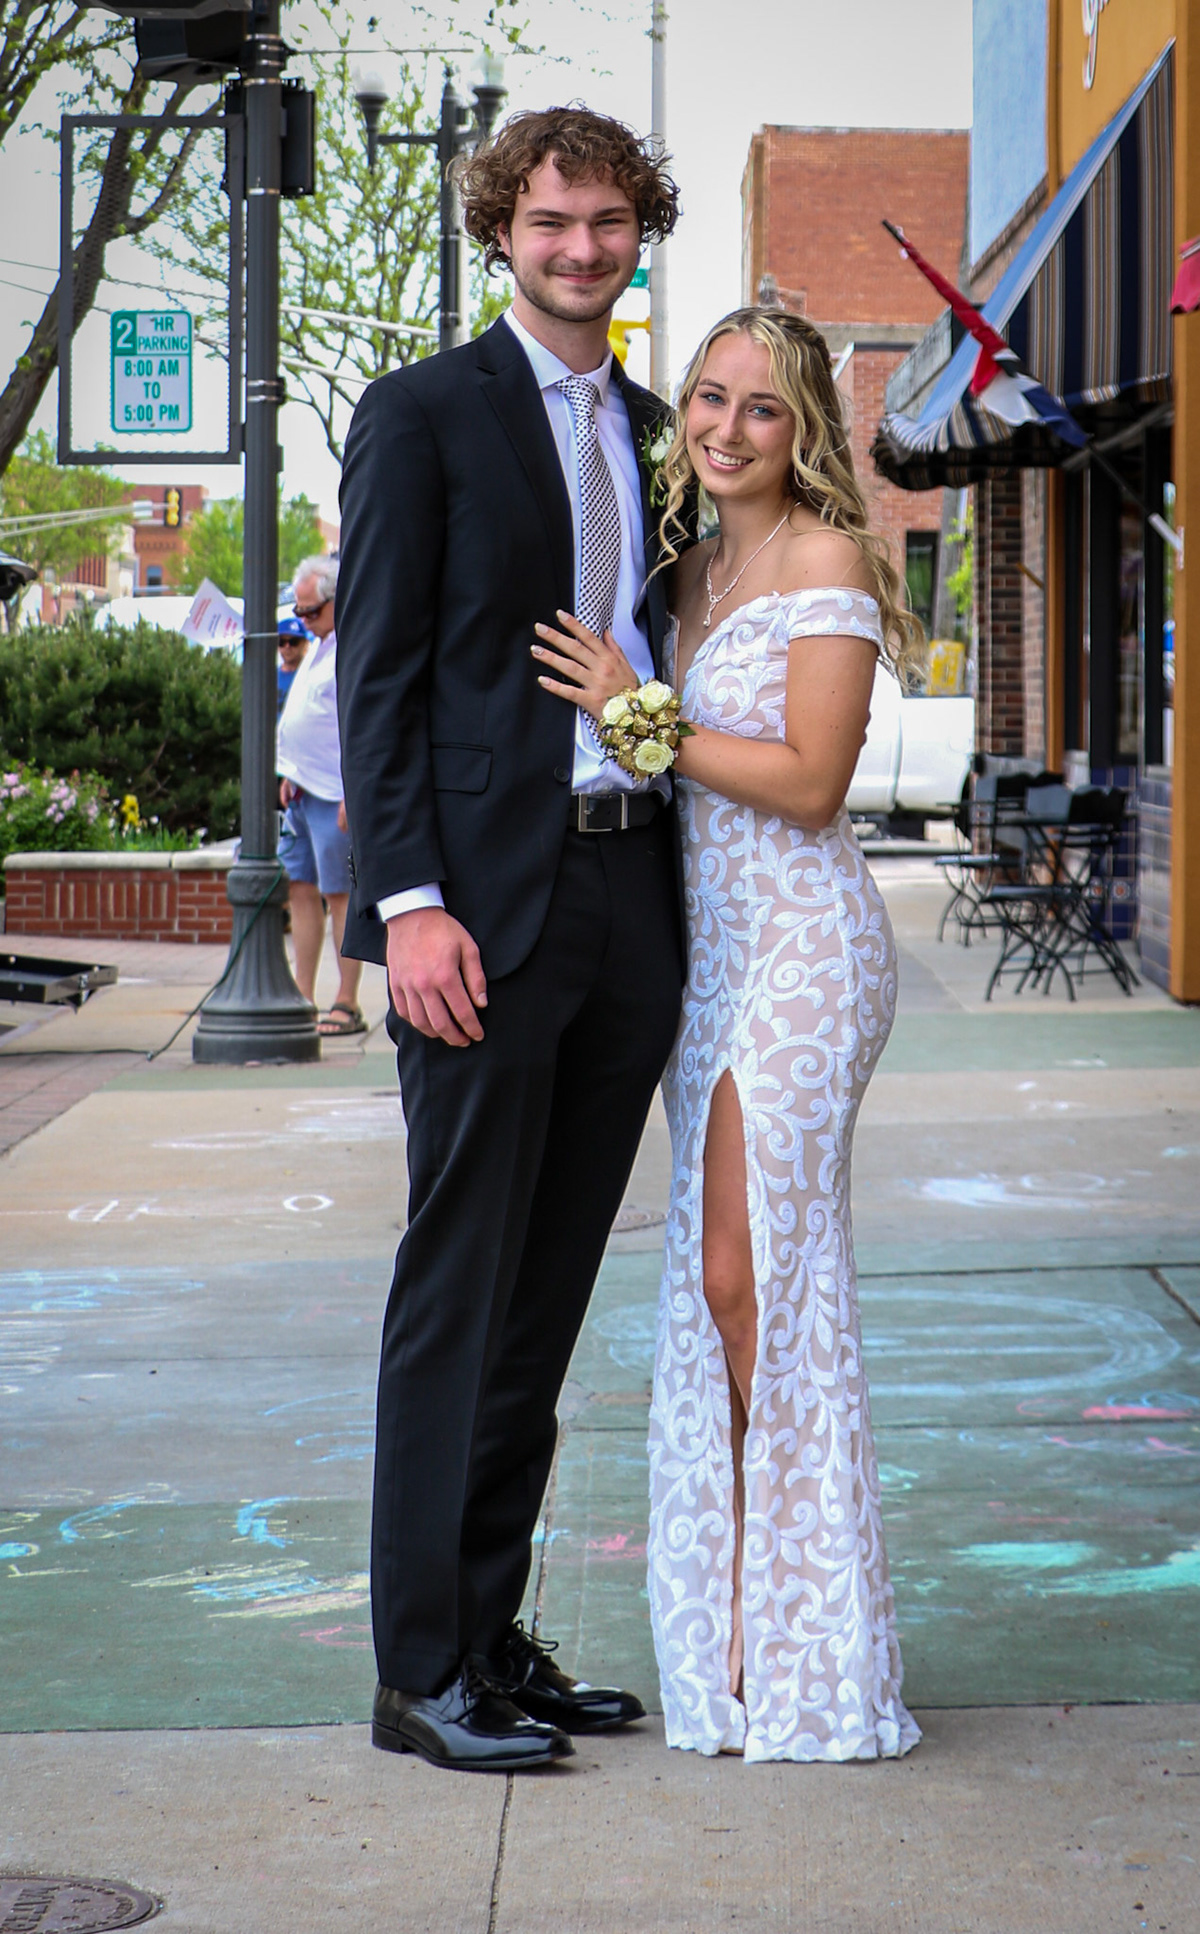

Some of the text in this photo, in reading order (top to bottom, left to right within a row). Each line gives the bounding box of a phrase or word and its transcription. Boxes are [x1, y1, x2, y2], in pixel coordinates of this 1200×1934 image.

[154, 316, 174, 331] HR
[116, 319, 134, 348] 2
[138, 336, 188, 351] PARKING
[124, 360, 179, 376] 8:00 AM
[143, 382, 161, 399] TO
[124, 405, 179, 422] 5:00 PM
